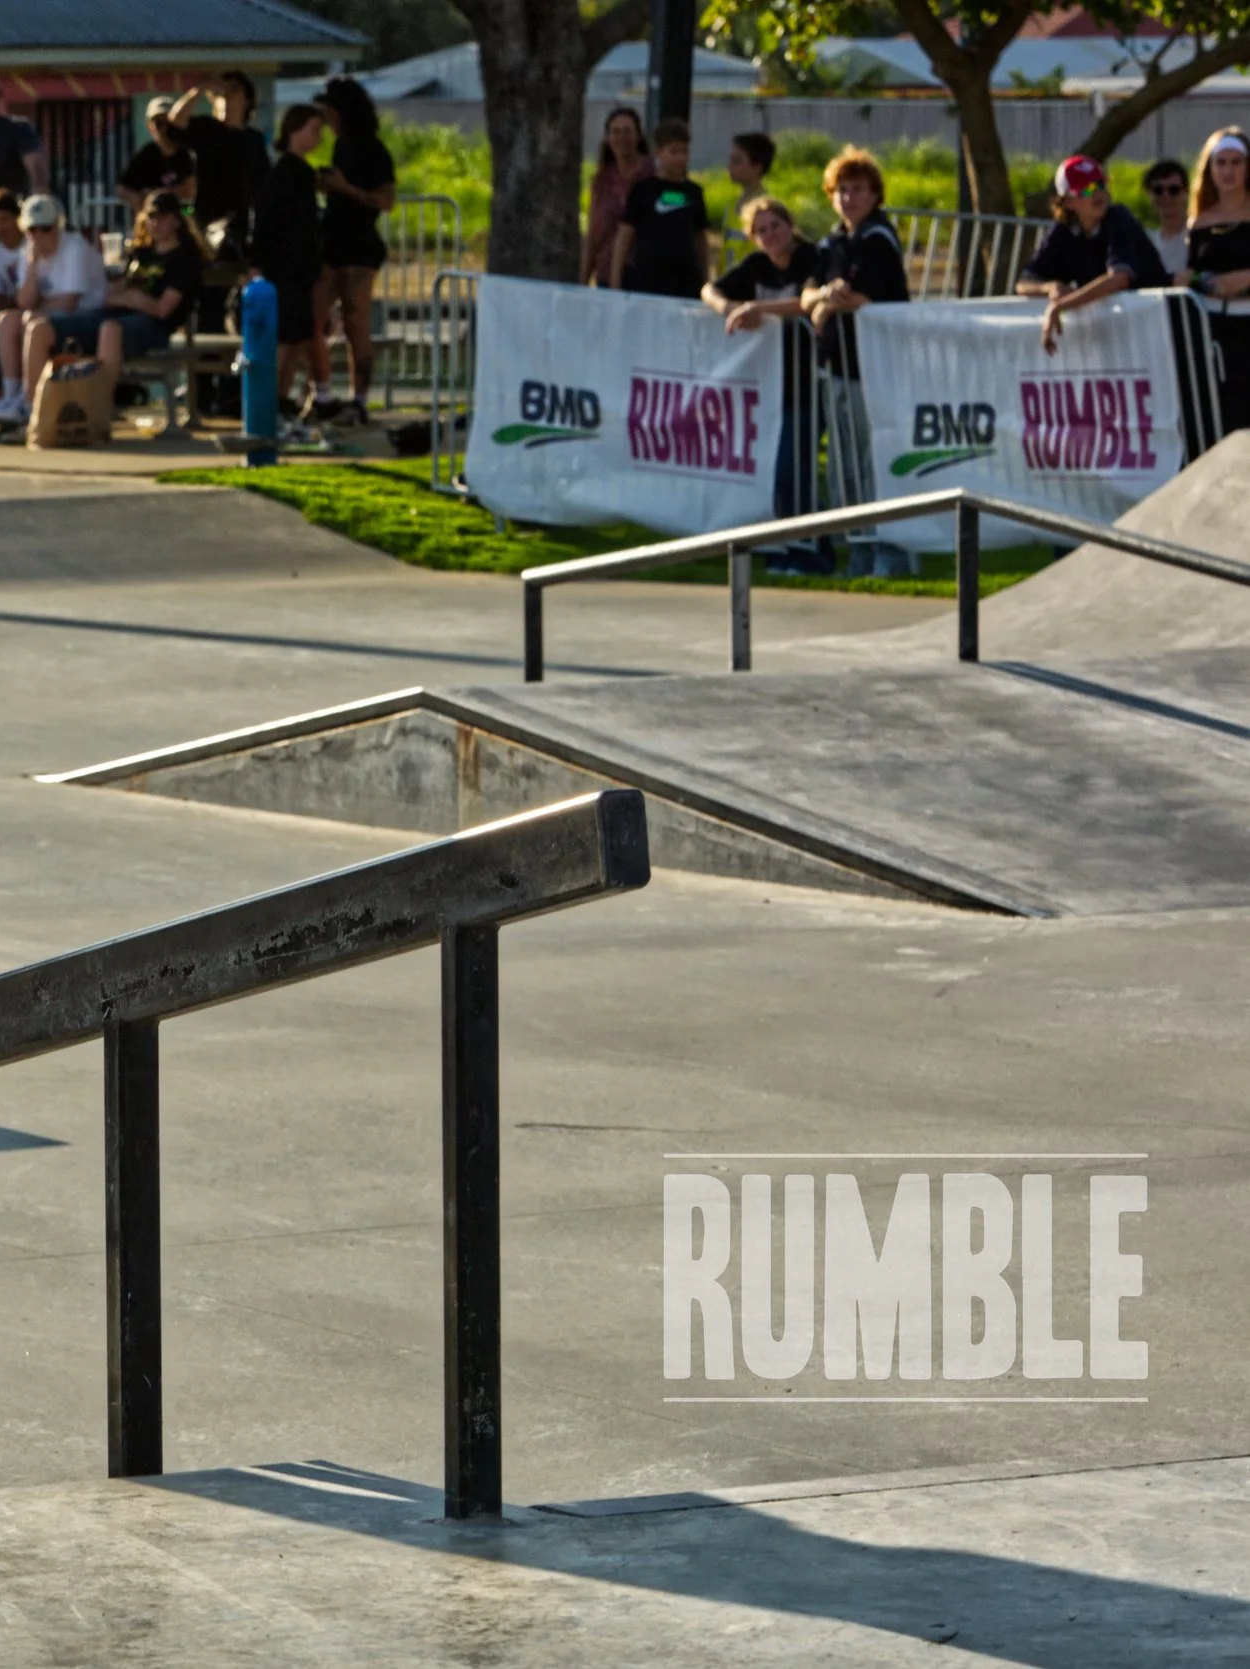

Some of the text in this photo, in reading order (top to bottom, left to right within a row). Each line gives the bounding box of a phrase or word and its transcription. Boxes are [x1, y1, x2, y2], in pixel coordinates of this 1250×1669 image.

[520, 376, 760, 475] BMD RUMBLE
[913, 379, 1157, 470] BMD RUMBLE
